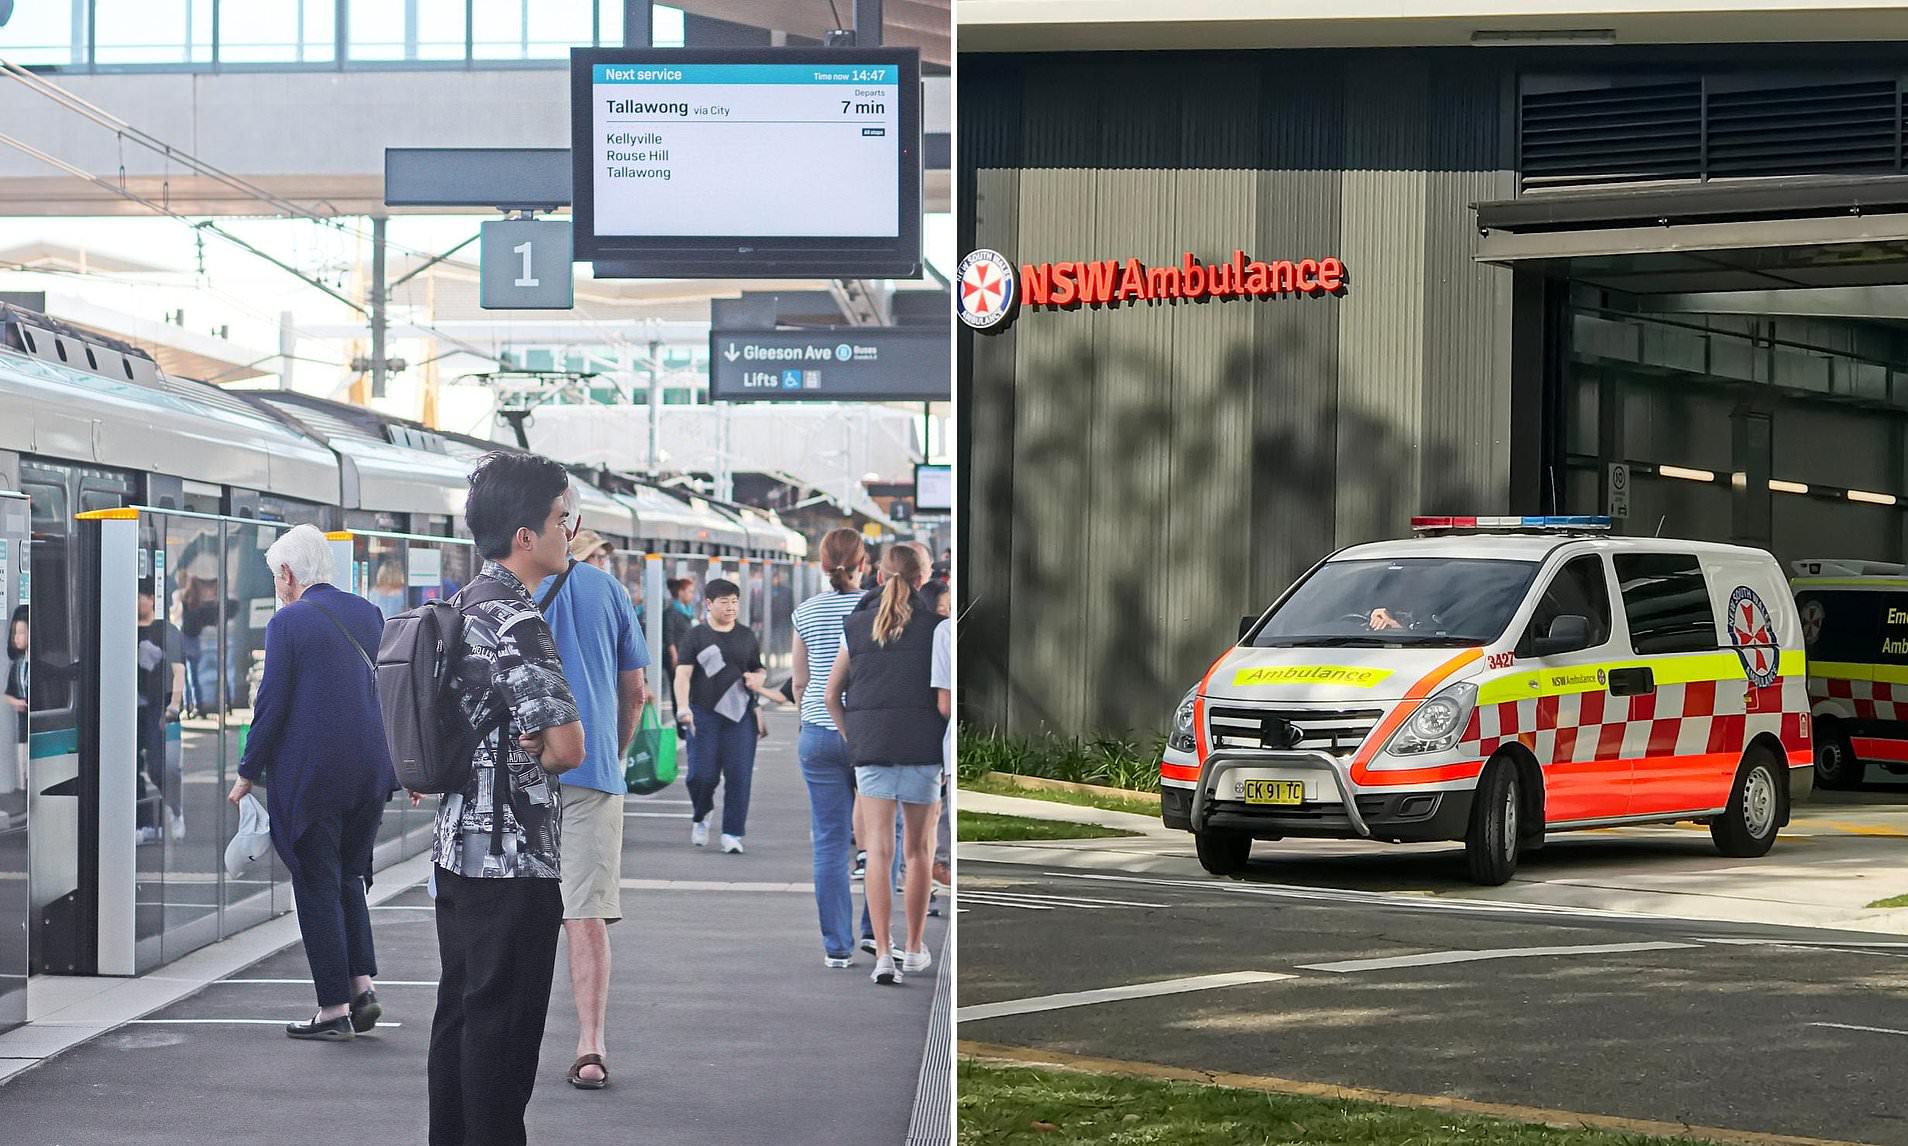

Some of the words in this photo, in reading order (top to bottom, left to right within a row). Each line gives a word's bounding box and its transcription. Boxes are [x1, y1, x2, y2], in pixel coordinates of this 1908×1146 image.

[605, 69, 635, 80] Next
[637, 69, 682, 80] service
[814, 72, 832, 80] Time
[852, 70, 886, 81] 14:47
[854, 89, 886, 97] Departs
[606, 100, 688, 116] Tallawong
[694, 106, 708, 115] via
[710, 106, 730, 116] City
[841, 101, 851, 114] 7
[855, 100, 885, 114] min
[606, 133, 662, 146] Kellyville
[606, 150, 646, 161] Rouse
[649, 150, 669, 161] Hill
[607, 166, 671, 180] Tallawong
[513, 241, 539, 287] 1
[1021, 259, 1119, 305] NSW
[1117, 250, 1343, 300] Ambulance
[743, 345, 802, 360] Gleeson
[804, 345, 832, 360] Ave
[743, 372, 778, 387] Lifts
[1487, 651, 1515, 669] 3427
[1247, 666, 1373, 682] Ambulance
[1247, 782, 1263, 798] CK
[1267, 783, 1280, 799] 91
[1287, 781, 1301, 799] TC
